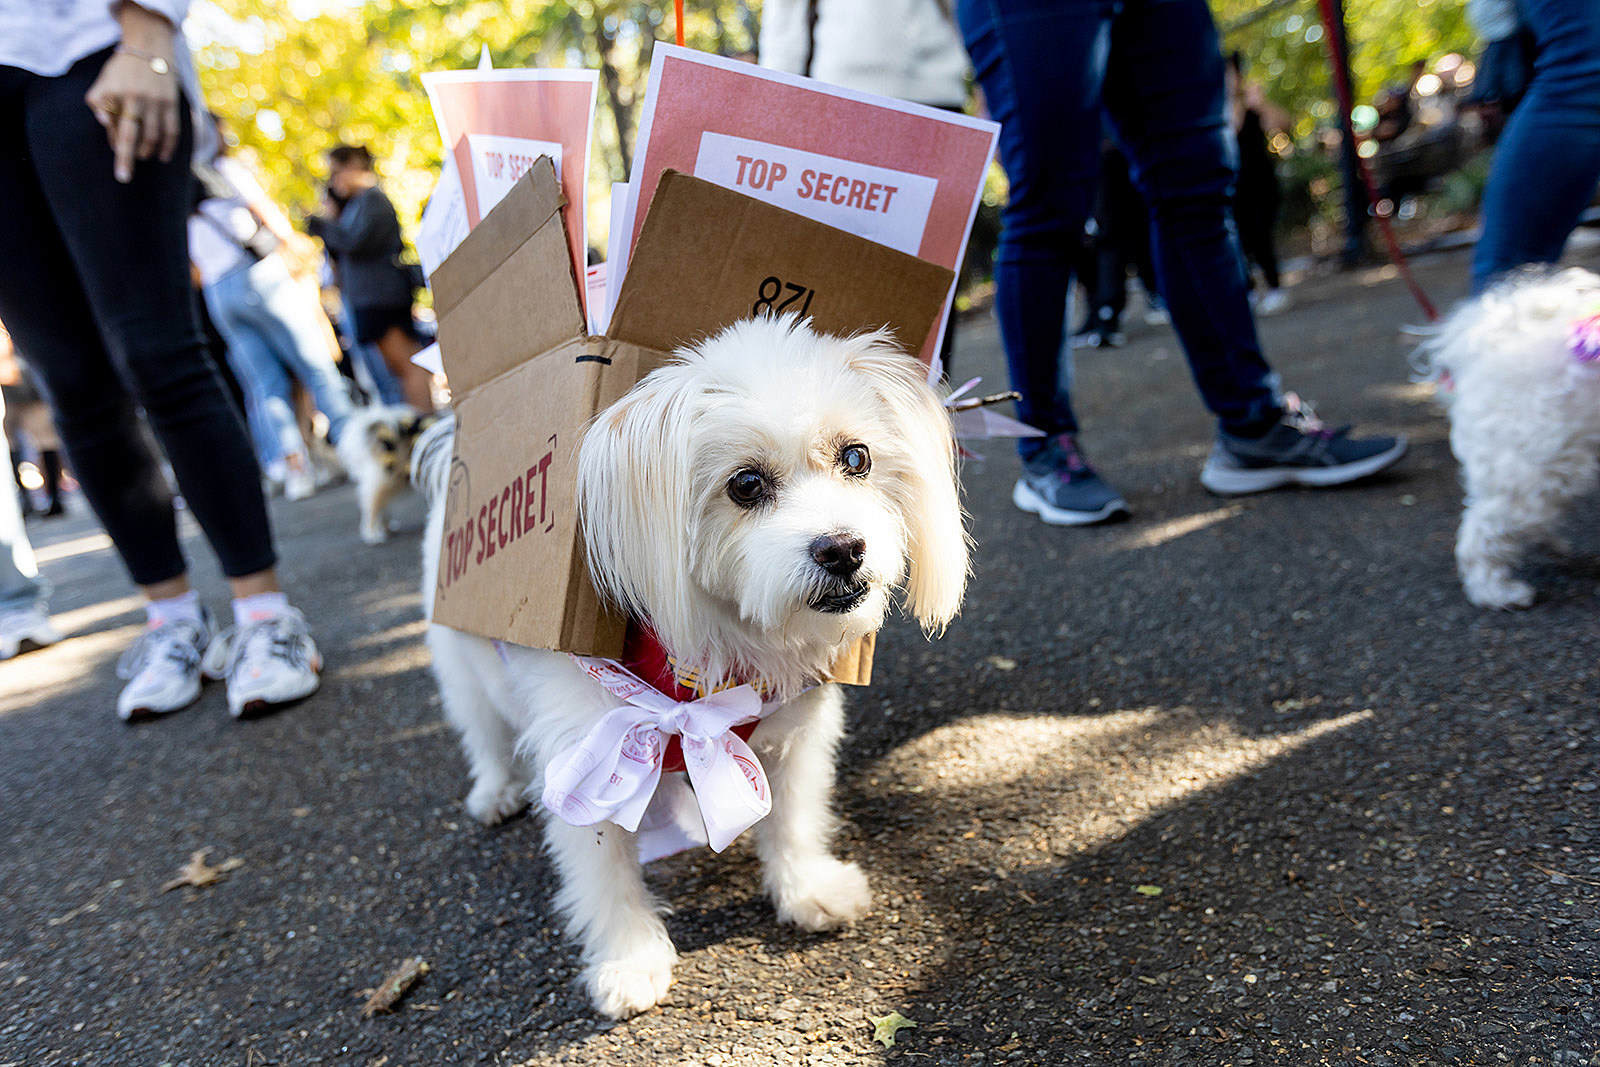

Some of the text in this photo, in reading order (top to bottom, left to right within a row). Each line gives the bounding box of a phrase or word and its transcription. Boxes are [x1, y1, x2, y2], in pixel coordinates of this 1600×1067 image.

[485, 151, 505, 179] TOP
[736, 155, 898, 213] TOP SECRET
[447, 451, 553, 587] TOP SECRET
